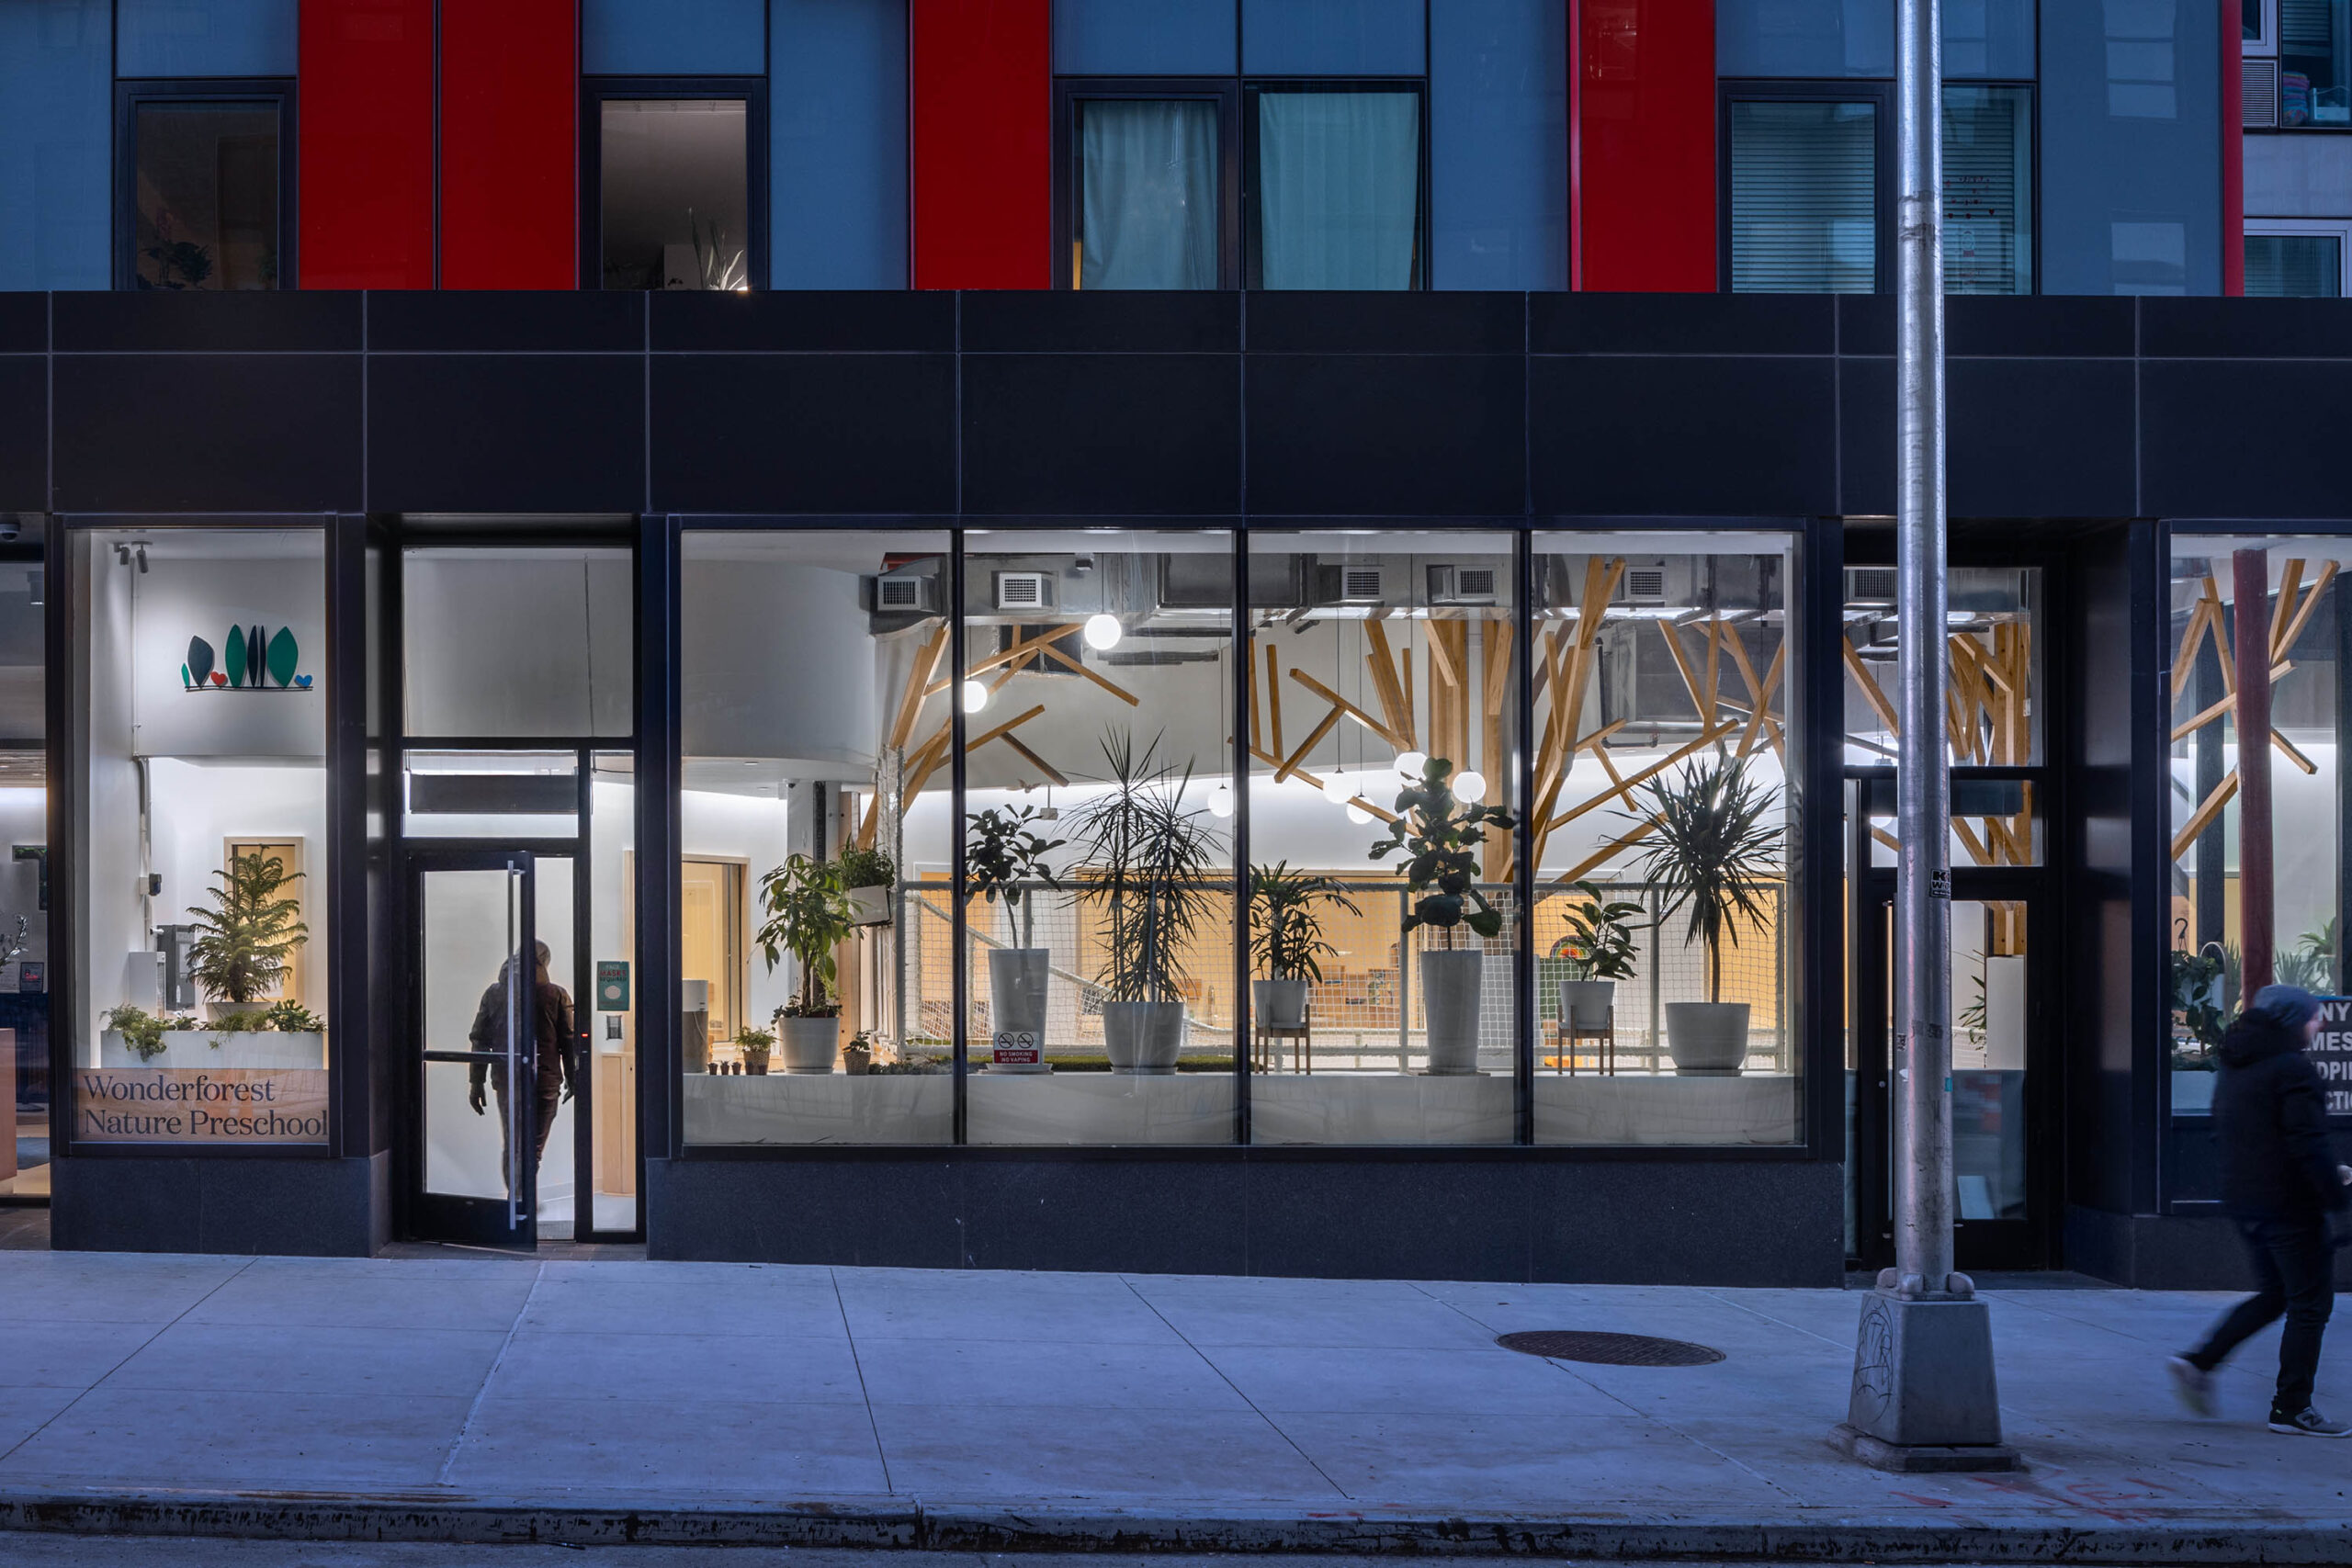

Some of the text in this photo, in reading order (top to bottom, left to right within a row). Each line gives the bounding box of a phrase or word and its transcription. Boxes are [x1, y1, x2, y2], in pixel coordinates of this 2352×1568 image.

[2306, 1032, 2352, 1051] MES
[84, 1074, 276, 1102] Wonderforest
[85, 1109, 329, 1136] Nature Preschool
